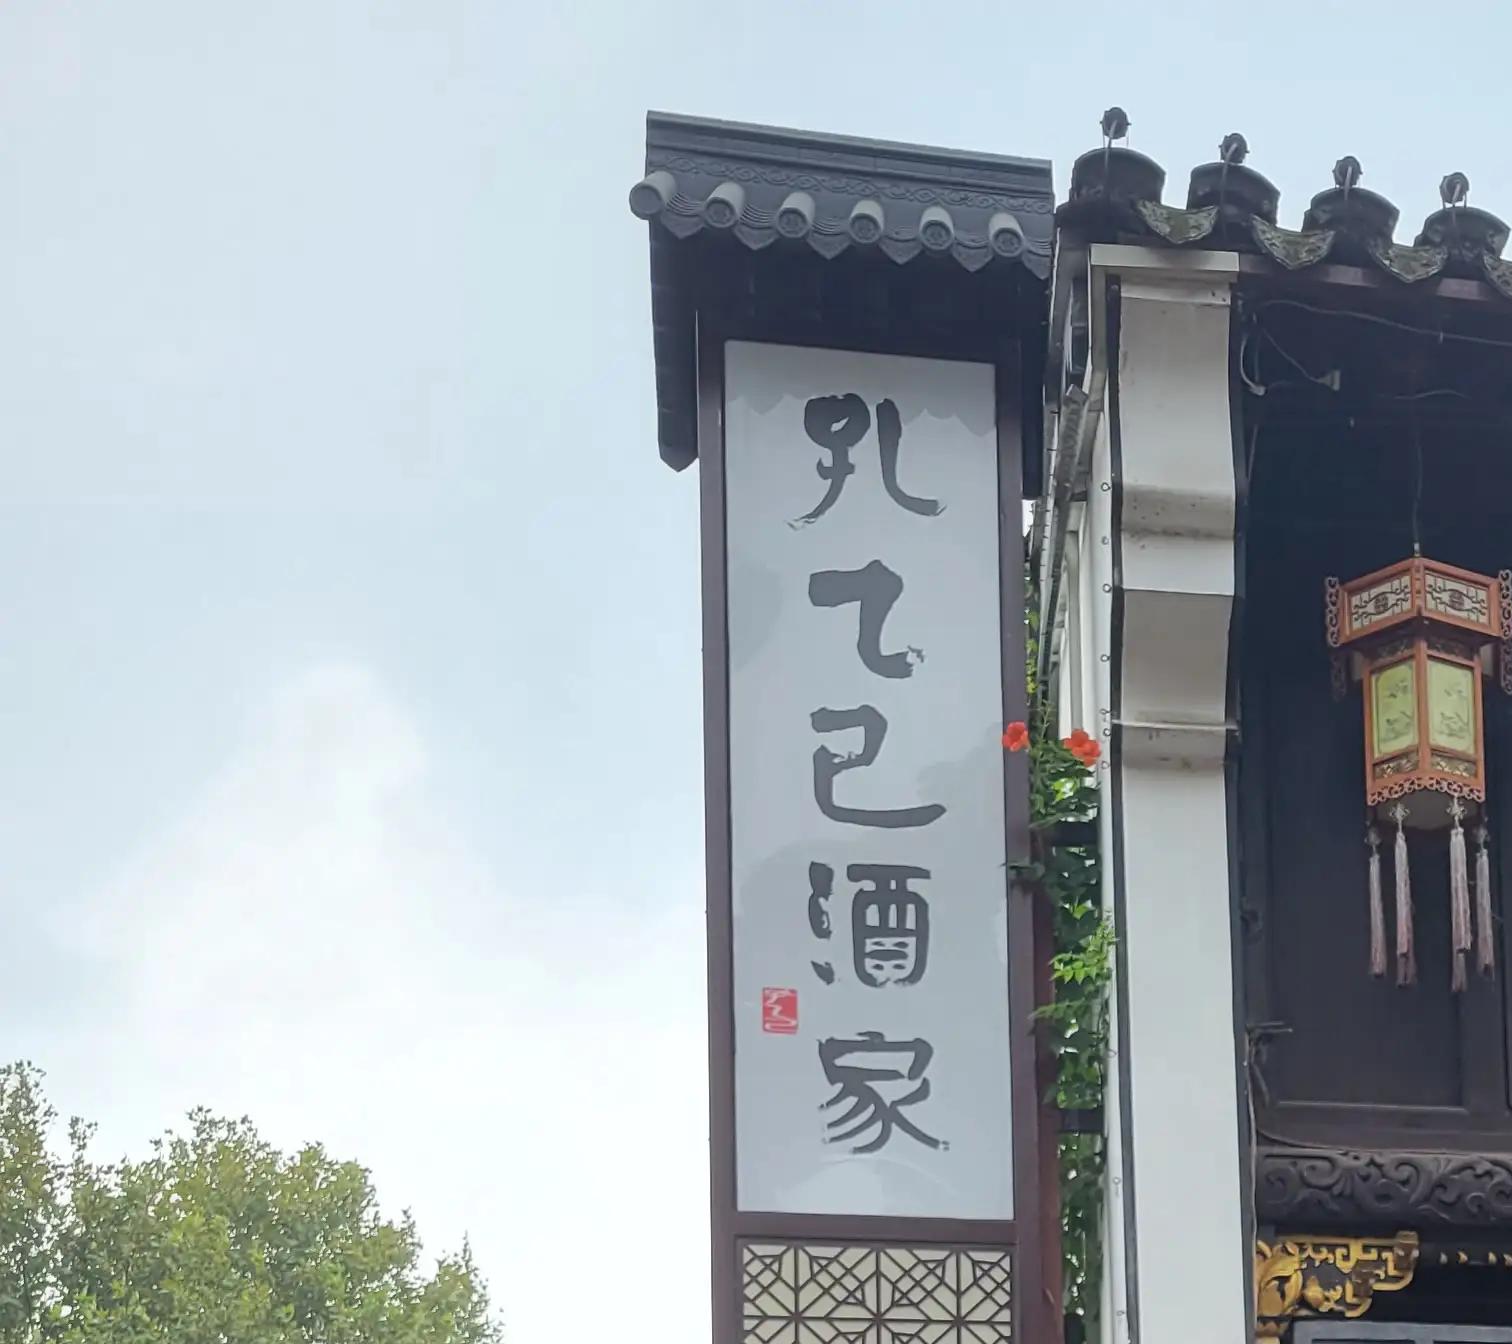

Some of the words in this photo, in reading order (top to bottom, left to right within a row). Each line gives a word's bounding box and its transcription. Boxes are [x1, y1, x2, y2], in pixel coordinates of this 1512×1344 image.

[786, 392, 952, 1156] 孔乙己酒家
